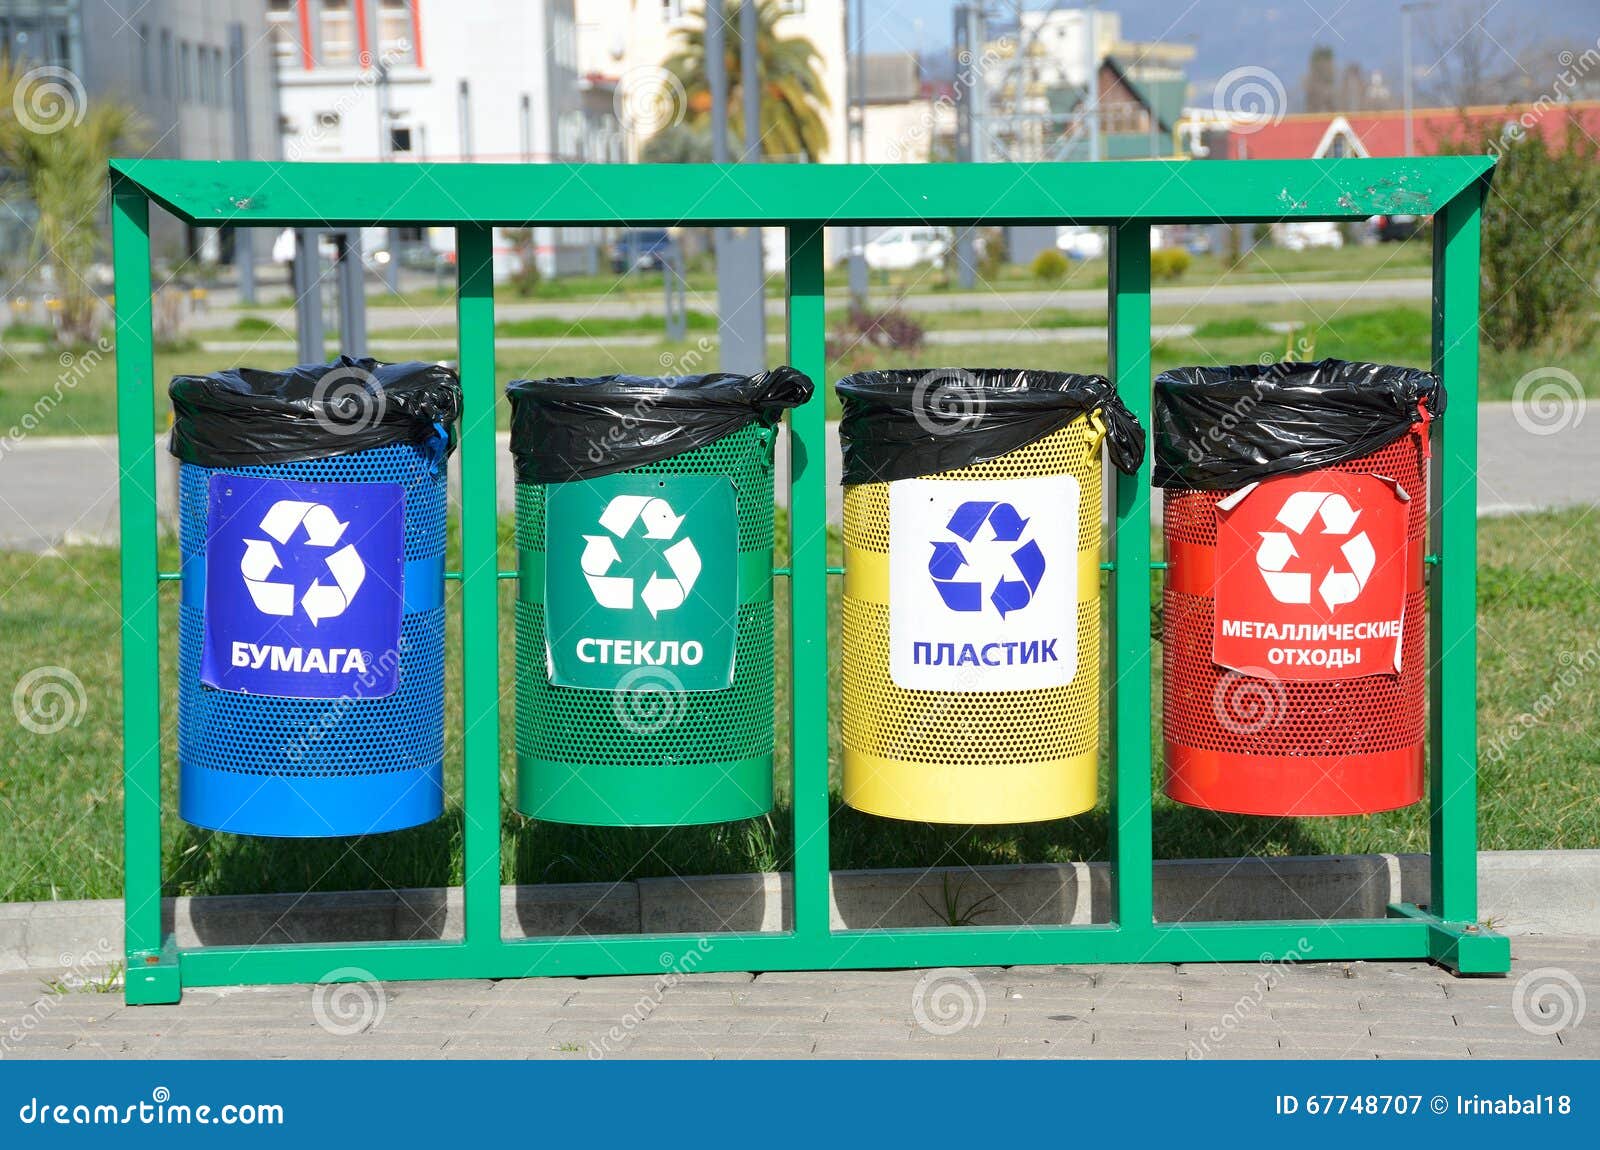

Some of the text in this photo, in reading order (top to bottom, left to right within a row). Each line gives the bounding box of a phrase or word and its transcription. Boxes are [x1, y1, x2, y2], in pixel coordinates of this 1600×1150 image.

[1221, 619, 1401, 642] МЕТАЛЛИЧЕСКИЕ
[231, 641, 367, 674] БУМАГА
[575, 637, 704, 667] СТЕКЛО
[912, 637, 1060, 667] ПЛАСТИК
[1266, 647, 1362, 669] ОТХОДЫ
